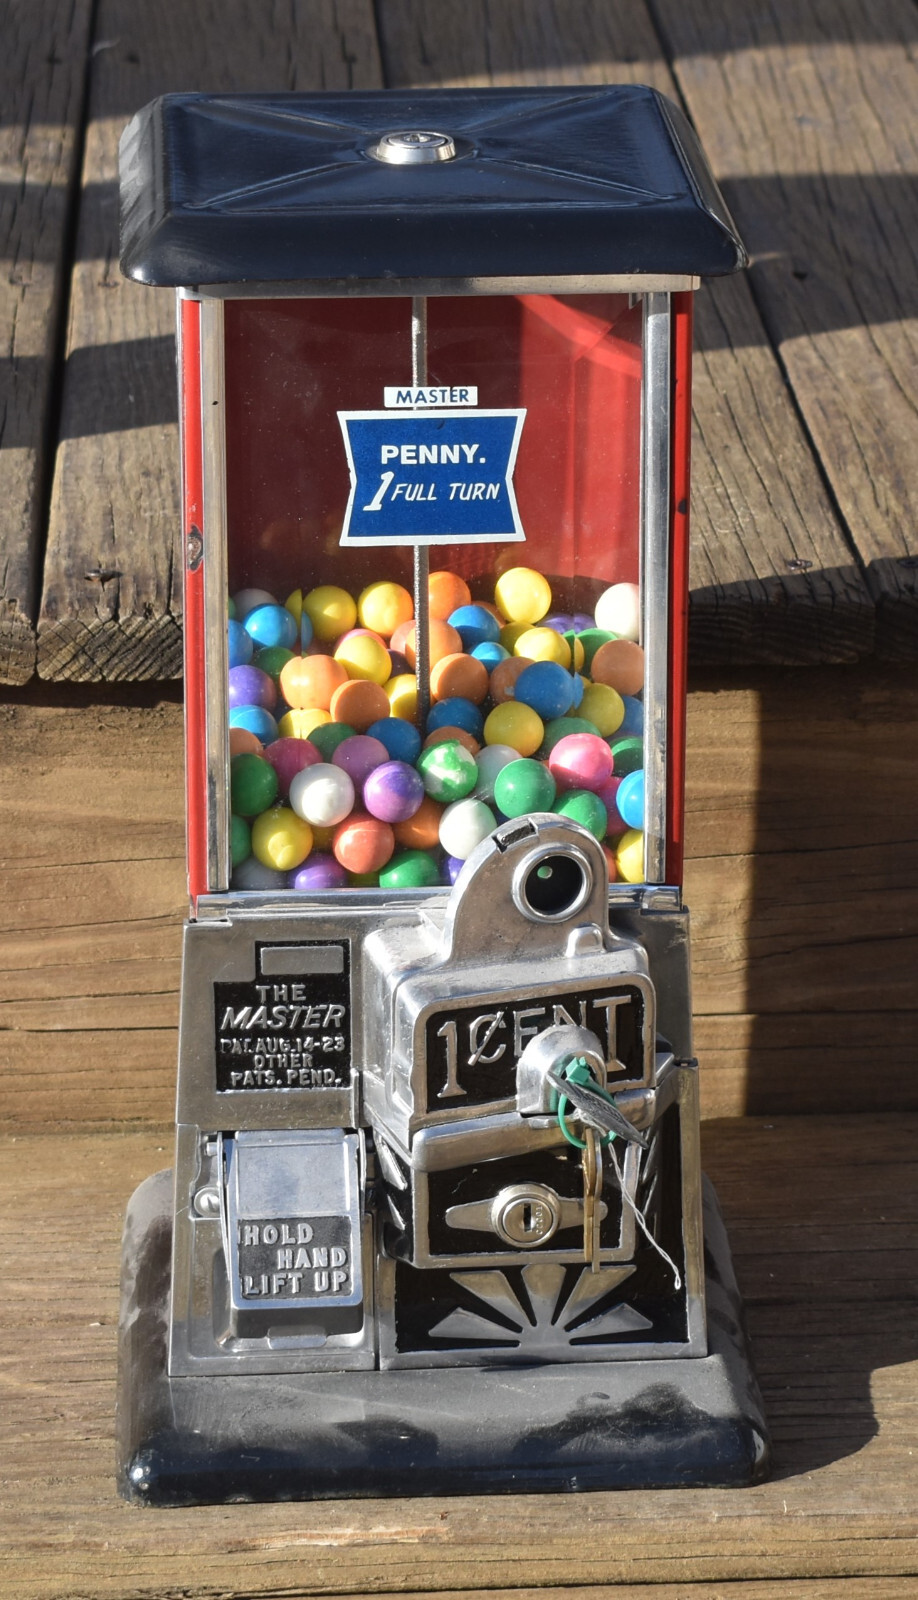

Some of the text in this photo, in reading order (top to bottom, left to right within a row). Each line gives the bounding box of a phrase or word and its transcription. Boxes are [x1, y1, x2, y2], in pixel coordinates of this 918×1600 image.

[396, 388, 469, 404] MASTER
[381, 444, 486, 465] PENNY.
[362, 471, 500, 511] 1 FULL TURN
[255, 984, 306, 1003] THE
[220, 1004, 346, 1030] MASTER
[254, 1053, 313, 1070] OTHER
[230, 1068, 342, 1087] PATS. PEND.
[243, 1222, 314, 1246] HOLD
[277, 1246, 347, 1270] HAND
[243, 1271, 347, 1295] LIFT UP
